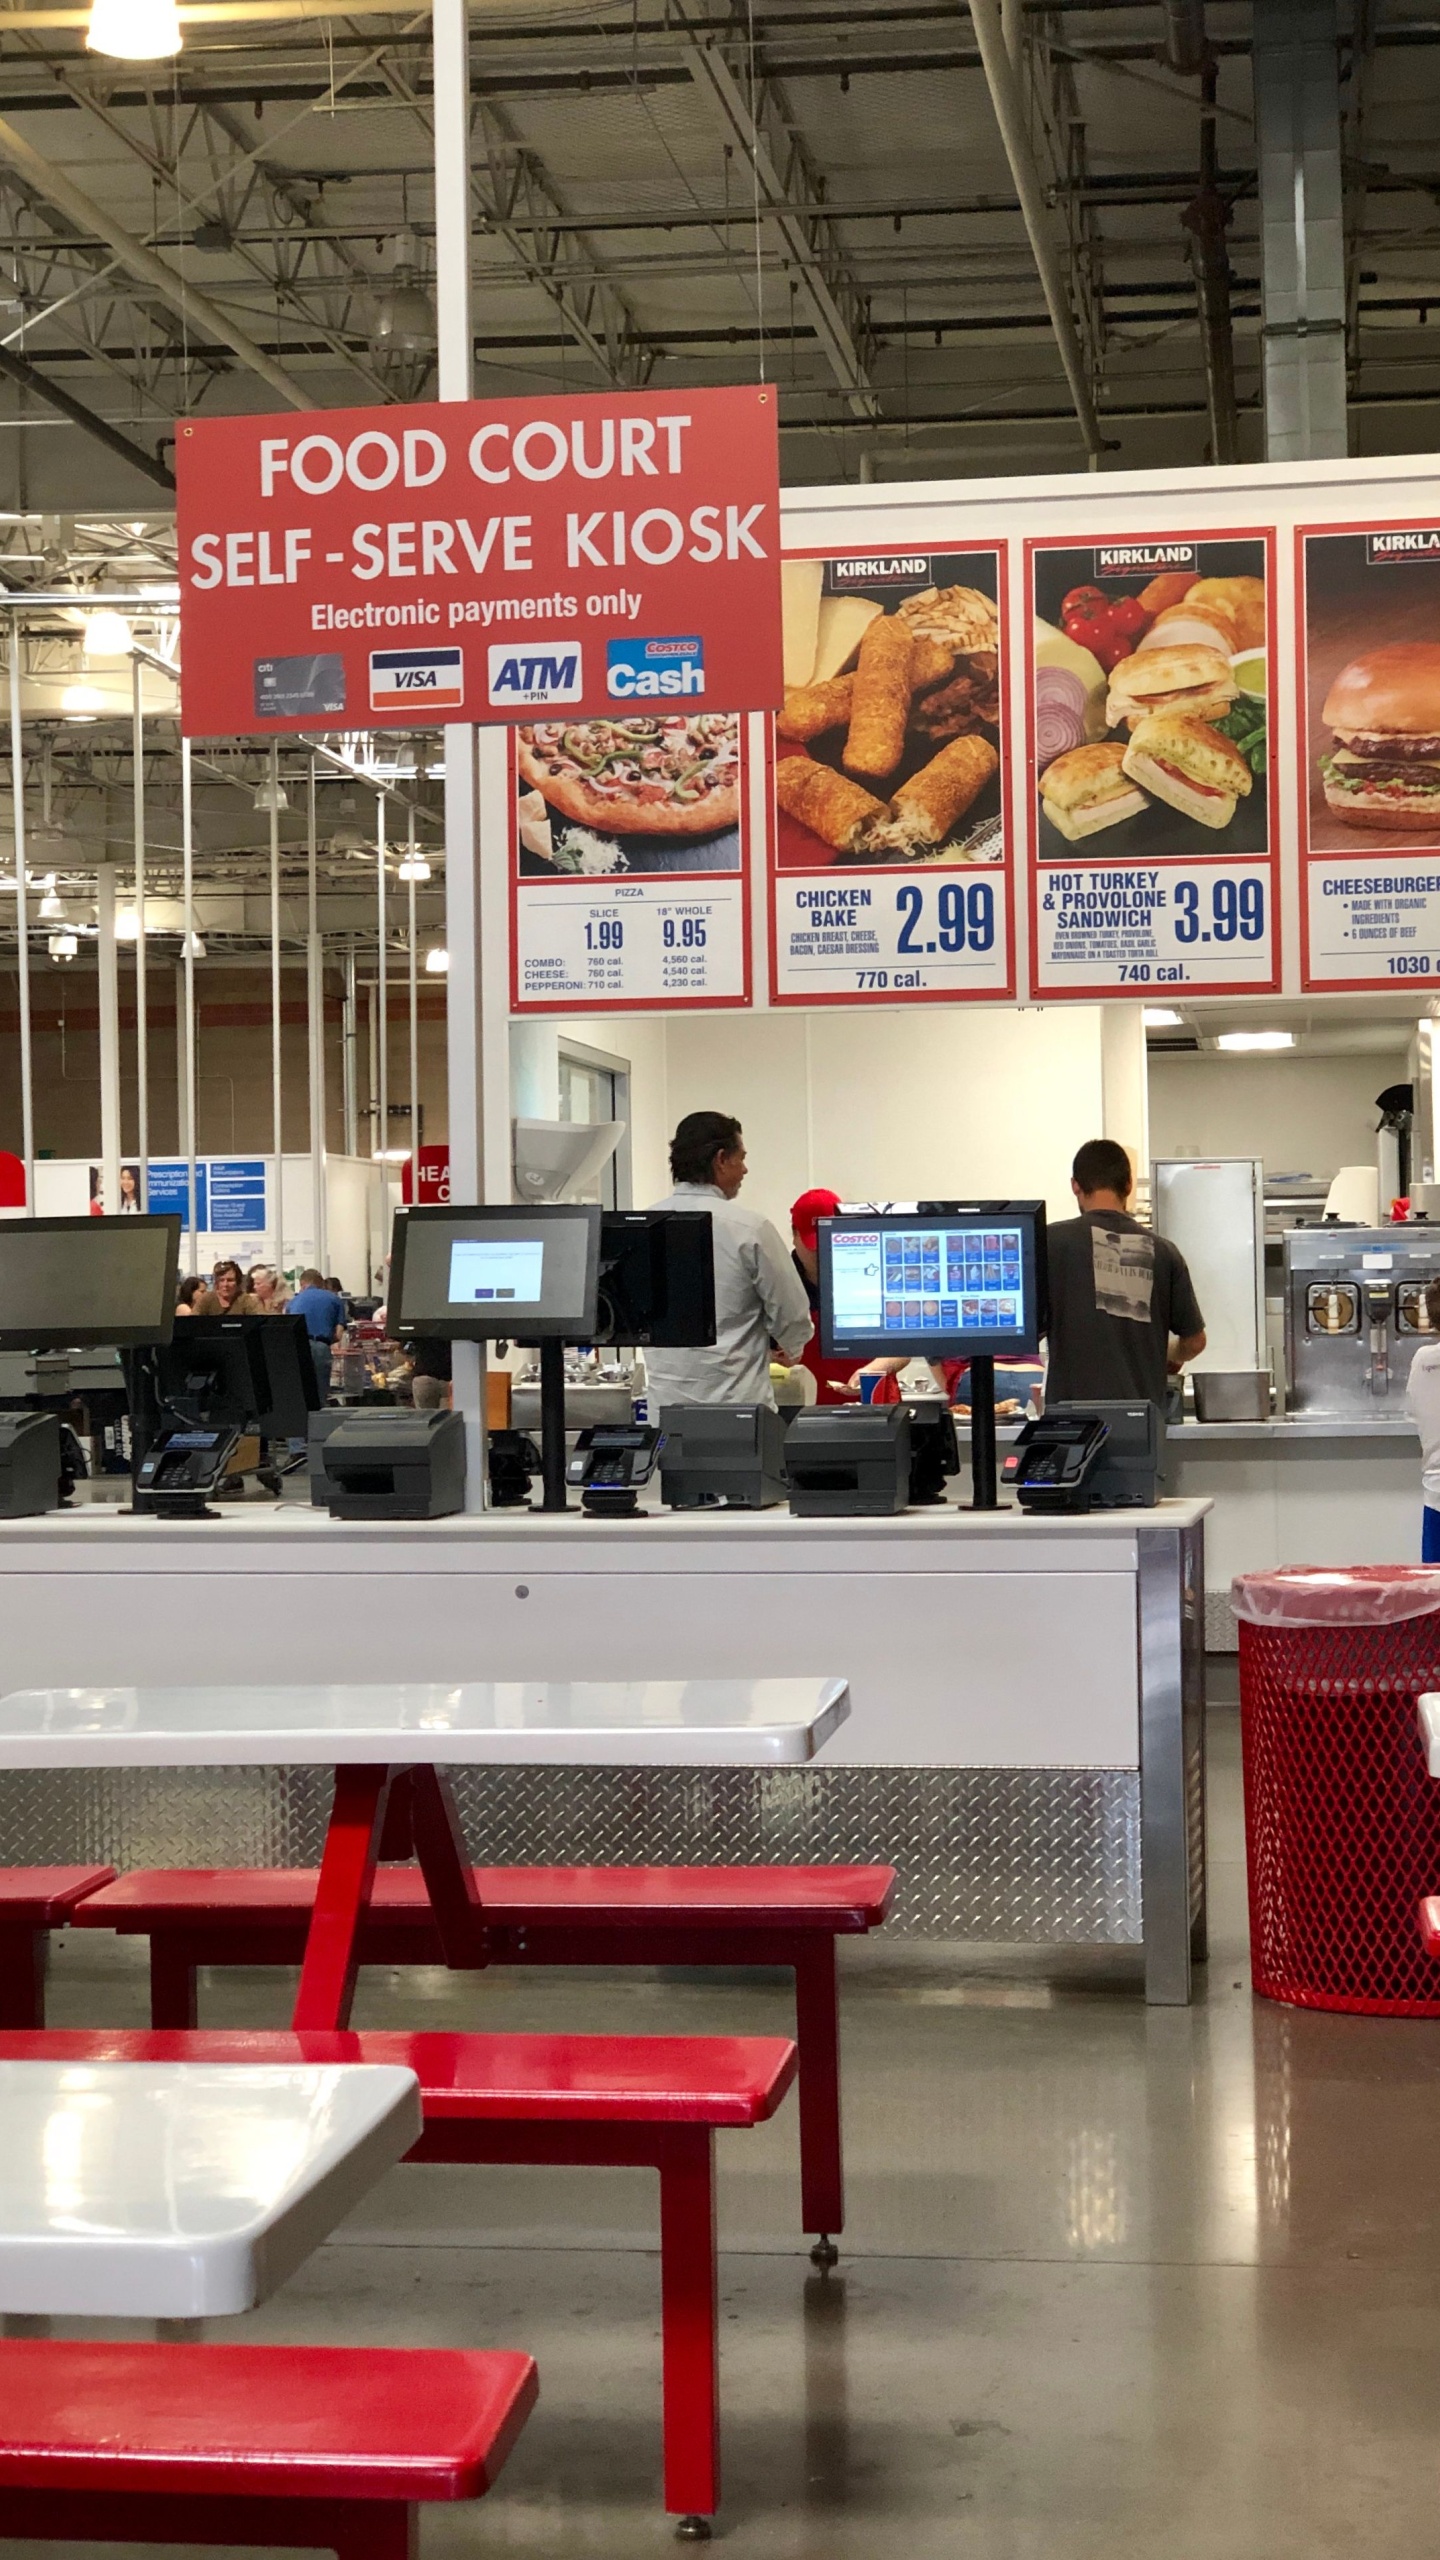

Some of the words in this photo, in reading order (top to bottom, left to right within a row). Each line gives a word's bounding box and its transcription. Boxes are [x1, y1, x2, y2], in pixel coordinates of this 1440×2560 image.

[260, 428, 447, 497] FOOD
[468, 415, 691, 484] COURT
[566, 503, 768, 569] KIOSK
[1373, 534, 1440, 551] KIRKLA
[1100, 546, 1192, 565] KIRKLAND
[837, 559, 927, 577] KIRKLAND
[311, 598, 440, 631] Electronic
[448, 591, 578, 628] payments
[586, 588, 642, 620] only
[647, 643, 697, 652] COSTCO
[394, 670, 437, 688] VISA
[492, 656, 578, 692] ATM
[606, 661, 705, 697] Cash
[522, 692, 548, 700] +PIN
[323, 703, 344, 711] VISA
[1049, 874, 1084, 892] HOT
[1089, 872, 1159, 890] TURKEY
[615, 888, 644, 897] PIZZA
[796, 889, 872, 908] CHICKEN
[1042, 894, 1056, 910] &
[1062, 890, 1166, 910] PROVOLONE
[656, 907, 672, 916] 18"
[676, 906, 712, 916] WHOLE
[1174, 878, 1264, 943] 3.99
[1352, 900, 1372, 911] MADE
[1374, 899, 1392, 910] WITH
[1394, 898, 1426, 910] ORGANIC
[590, 909, 619, 918] SLICE
[811, 910, 857, 927] BAKE
[896, 883, 994, 954] 2.99
[1057, 910, 1151, 929] SANDWICH
[1352, 912, 1400, 924] INGREDIENTS
[584, 921, 624, 950] 1.99
[663, 919, 706, 948] 9.95
[791, 932, 820, 943] CHICKEN
[822, 931, 848, 942] BREAST,
[851, 930, 878, 942] CHEESE,
[1352, 928, 1357, 940] 6
[1359, 928, 1387, 940] OUNCES
[1390, 927, 1398, 938] OF
[1400, 926, 1416, 938] BEEF
[790, 945, 816, 956] BACON,
[818, 944, 844, 954] CAESAR
[846, 942, 880, 954] DRESSING
[524, 959, 566, 968] COMBO:
[588, 957, 604, 966] 760
[607, 956, 624, 966] cal.
[662, 955, 688, 964] 4,560
[690, 954, 707, 964] cal.
[1387, 956, 1430, 974] 1030
[524, 970, 568, 979] CHEESE:
[588, 969, 604, 978] 760
[607, 968, 624, 977] cal.
[662, 967, 688, 976] 4,540
[690, 966, 707, 976] cal.
[856, 971, 888, 988] 770
[894, 970, 926, 987] cal.
[1118, 964, 1150, 982] 740
[1156, 963, 1190, 981] cal.
[524, 982, 586, 990] PEPPERONI:
[588, 980, 604, 989] 710
[607, 980, 624, 988] cal.
[662, 978, 688, 988] 4,230
[690, 978, 707, 987] cal.
[833, 1234, 878, 1244] COSTCO
